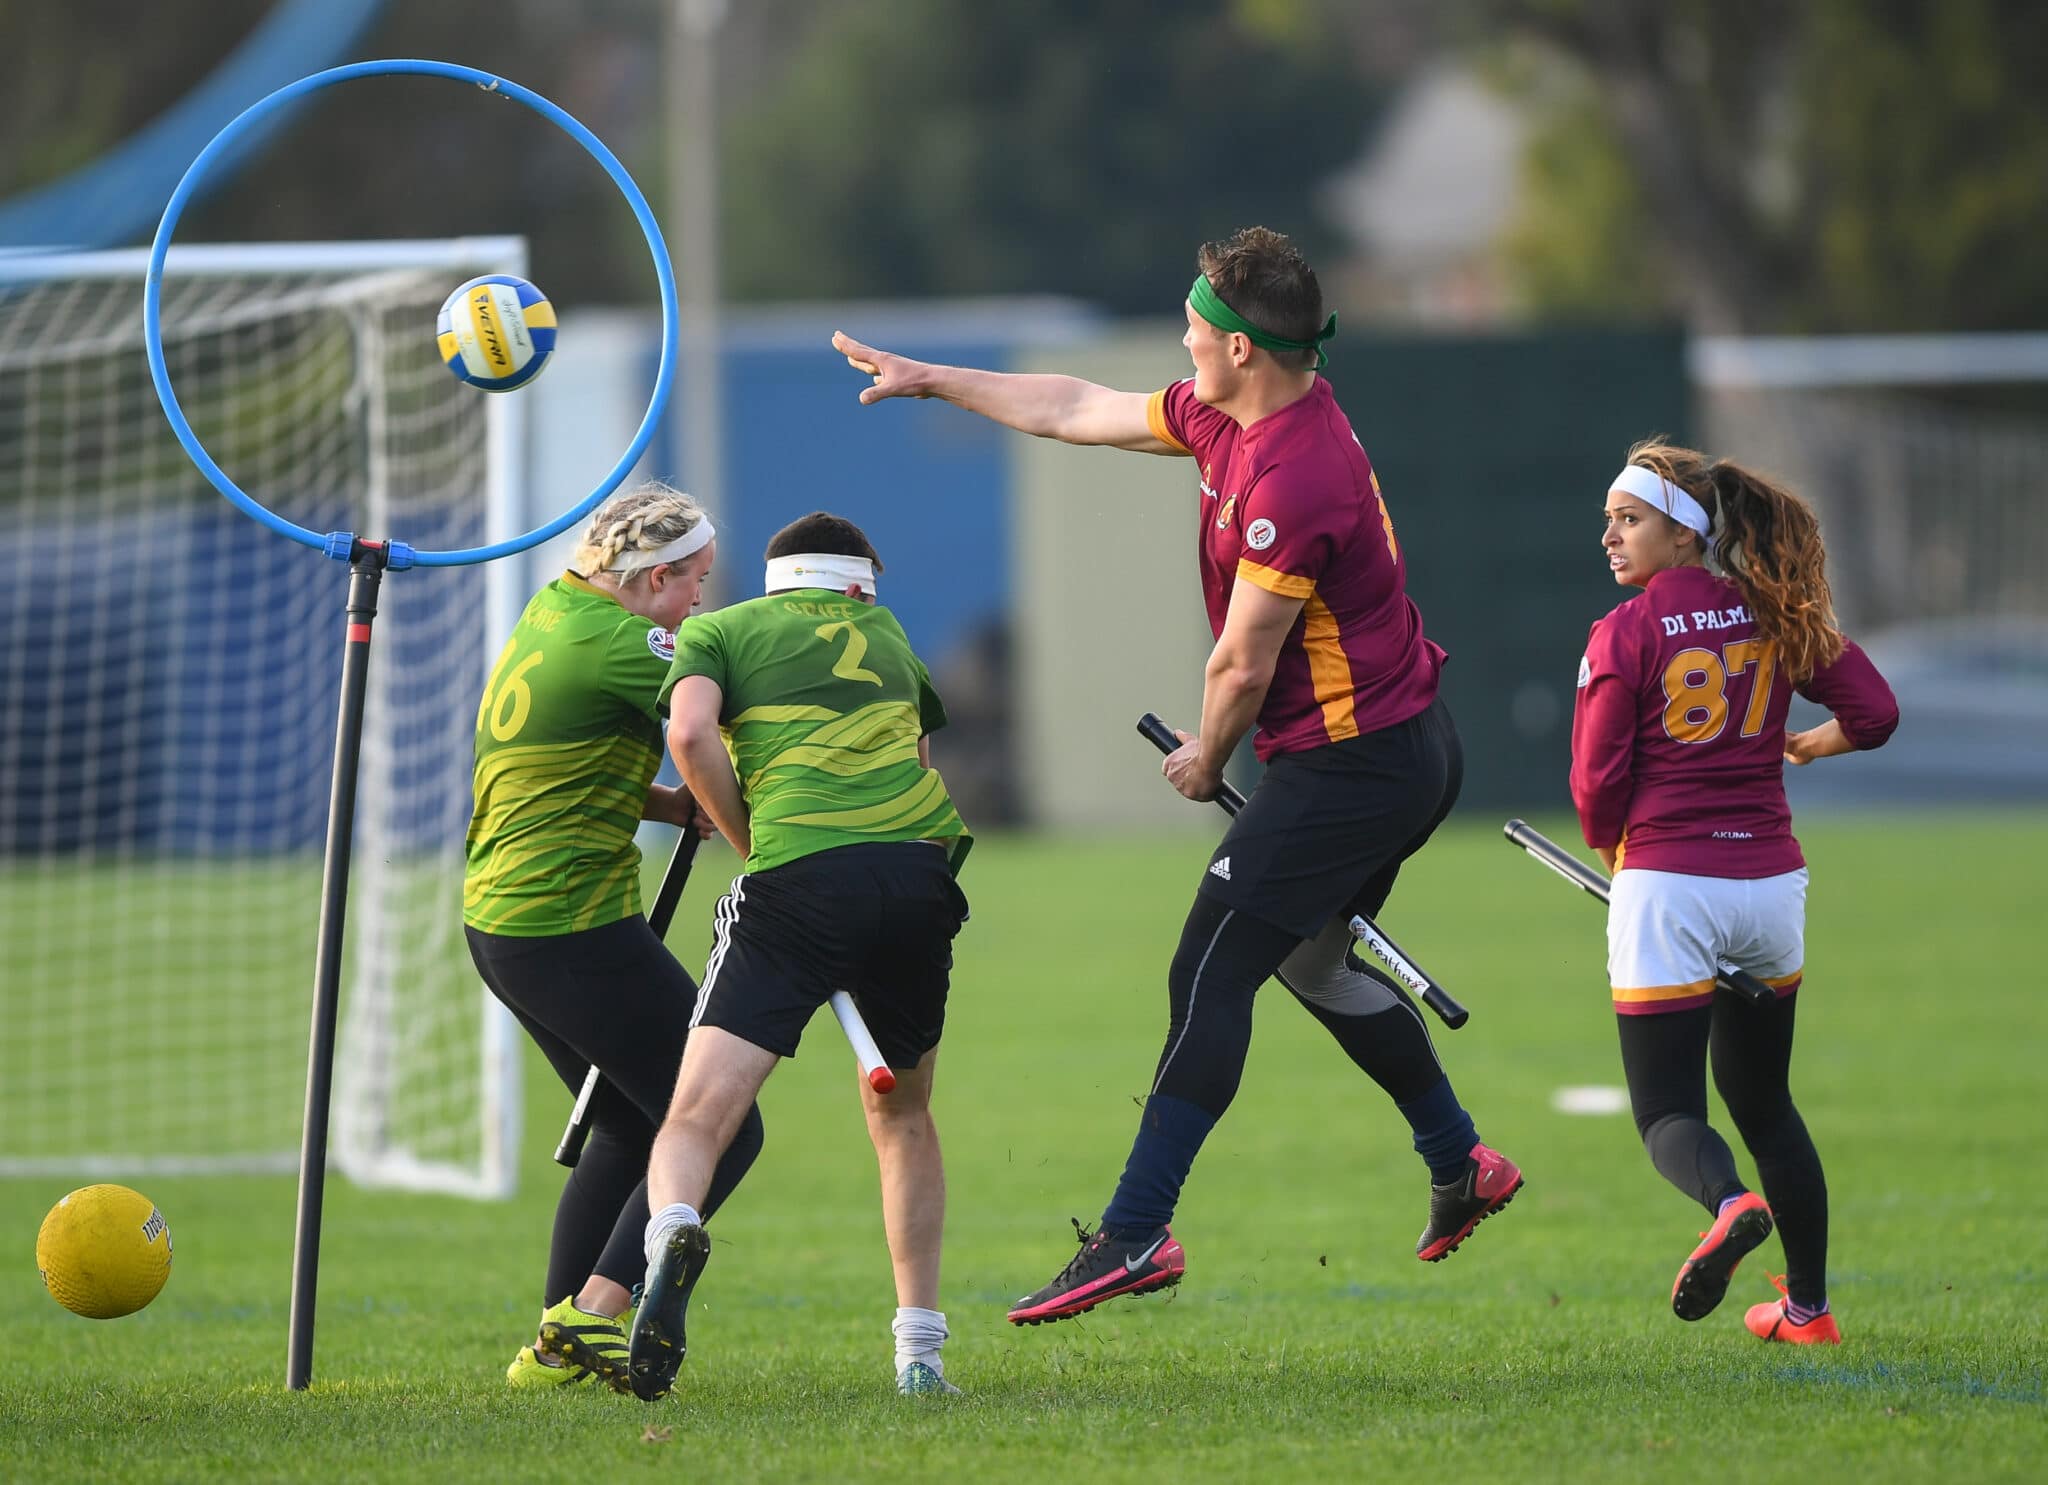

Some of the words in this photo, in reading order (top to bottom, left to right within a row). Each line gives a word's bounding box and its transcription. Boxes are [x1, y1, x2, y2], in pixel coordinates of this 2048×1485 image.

[1661, 614, 1688, 636] DI
[815, 620, 884, 688] 2
[1662, 638, 1777, 744] 87
[1711, 831, 1753, 839] AKUMA
